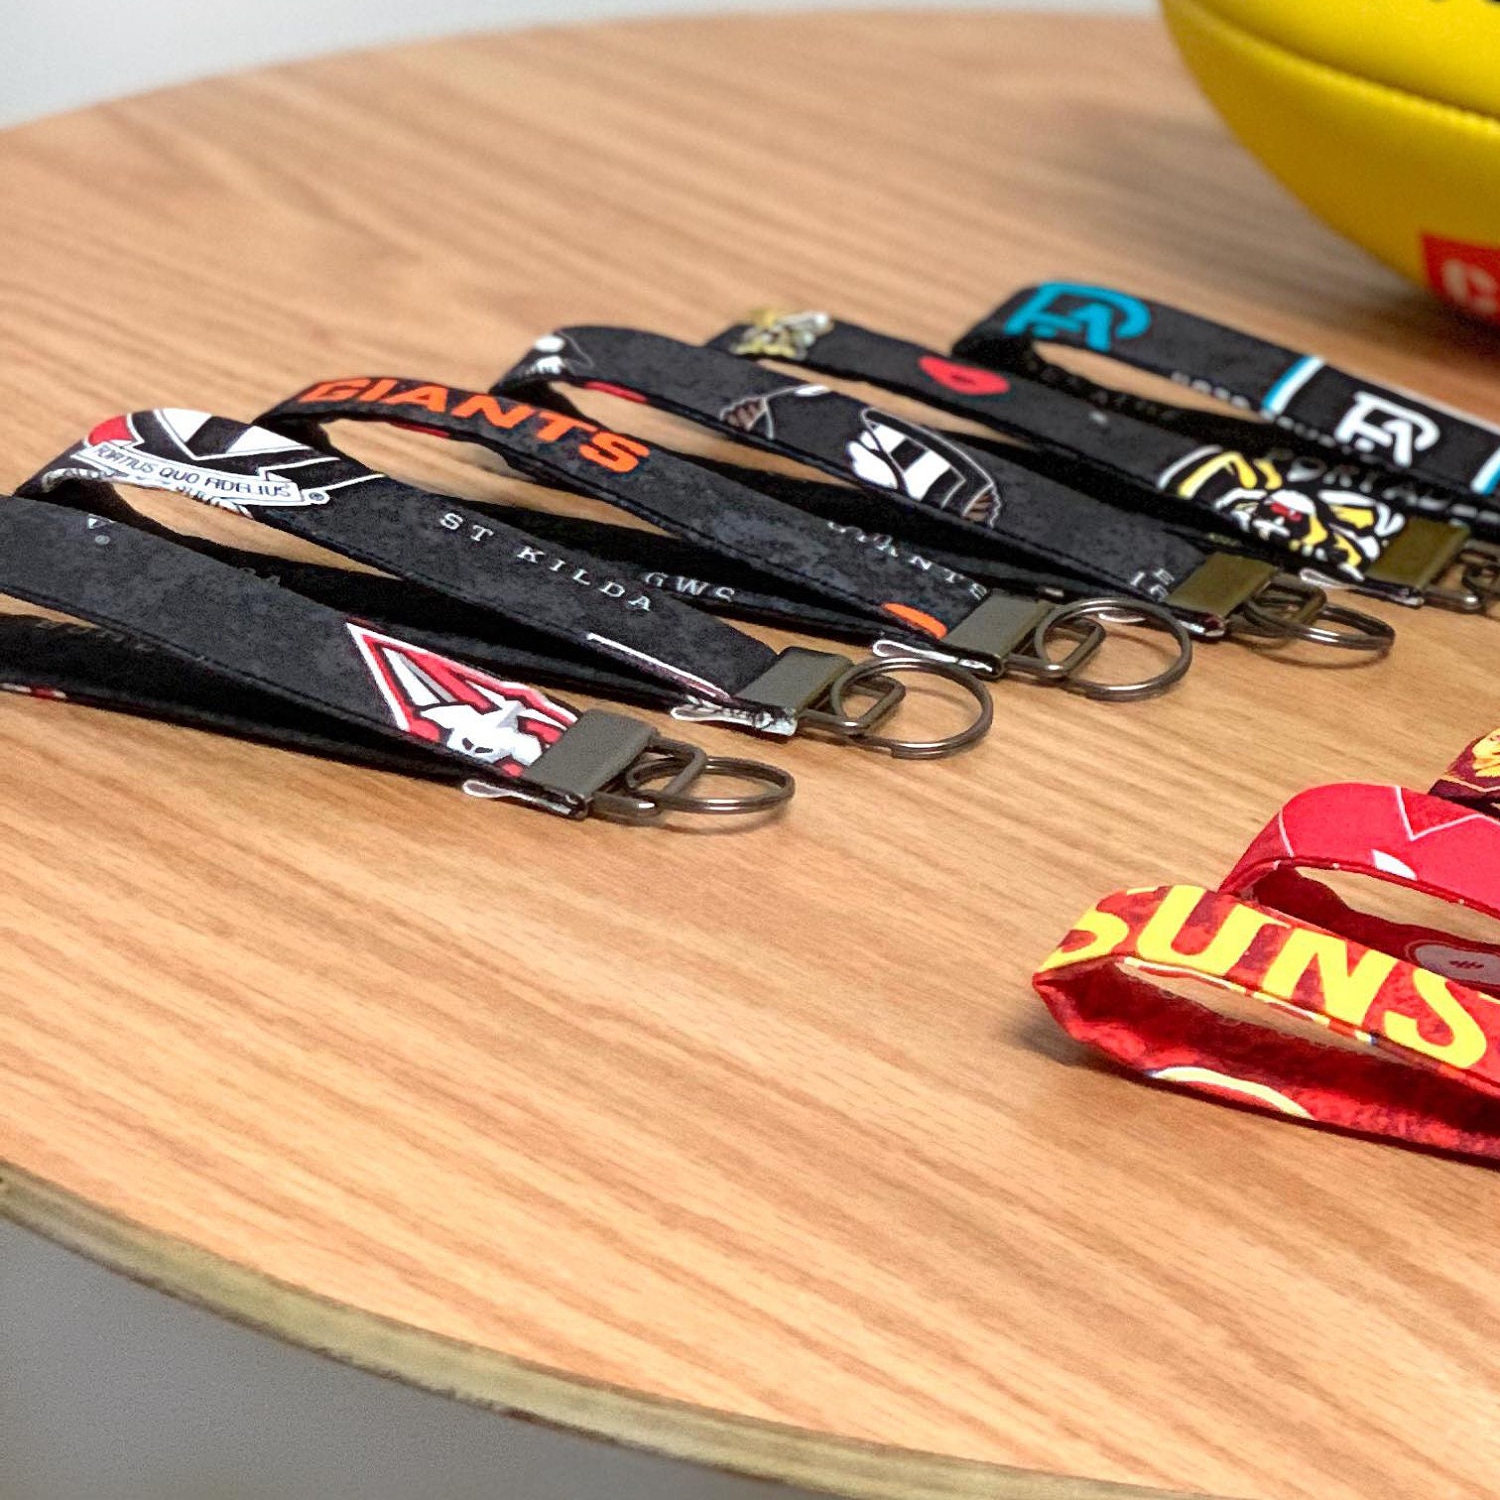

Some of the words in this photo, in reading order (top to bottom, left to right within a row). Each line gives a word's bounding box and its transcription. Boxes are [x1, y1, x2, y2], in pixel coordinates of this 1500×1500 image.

[298, 376, 650, 474] GIANTS
[159, 466, 201, 485] QUO
[440, 511, 493, 542] ST
[516, 544, 652, 612] KILDA
